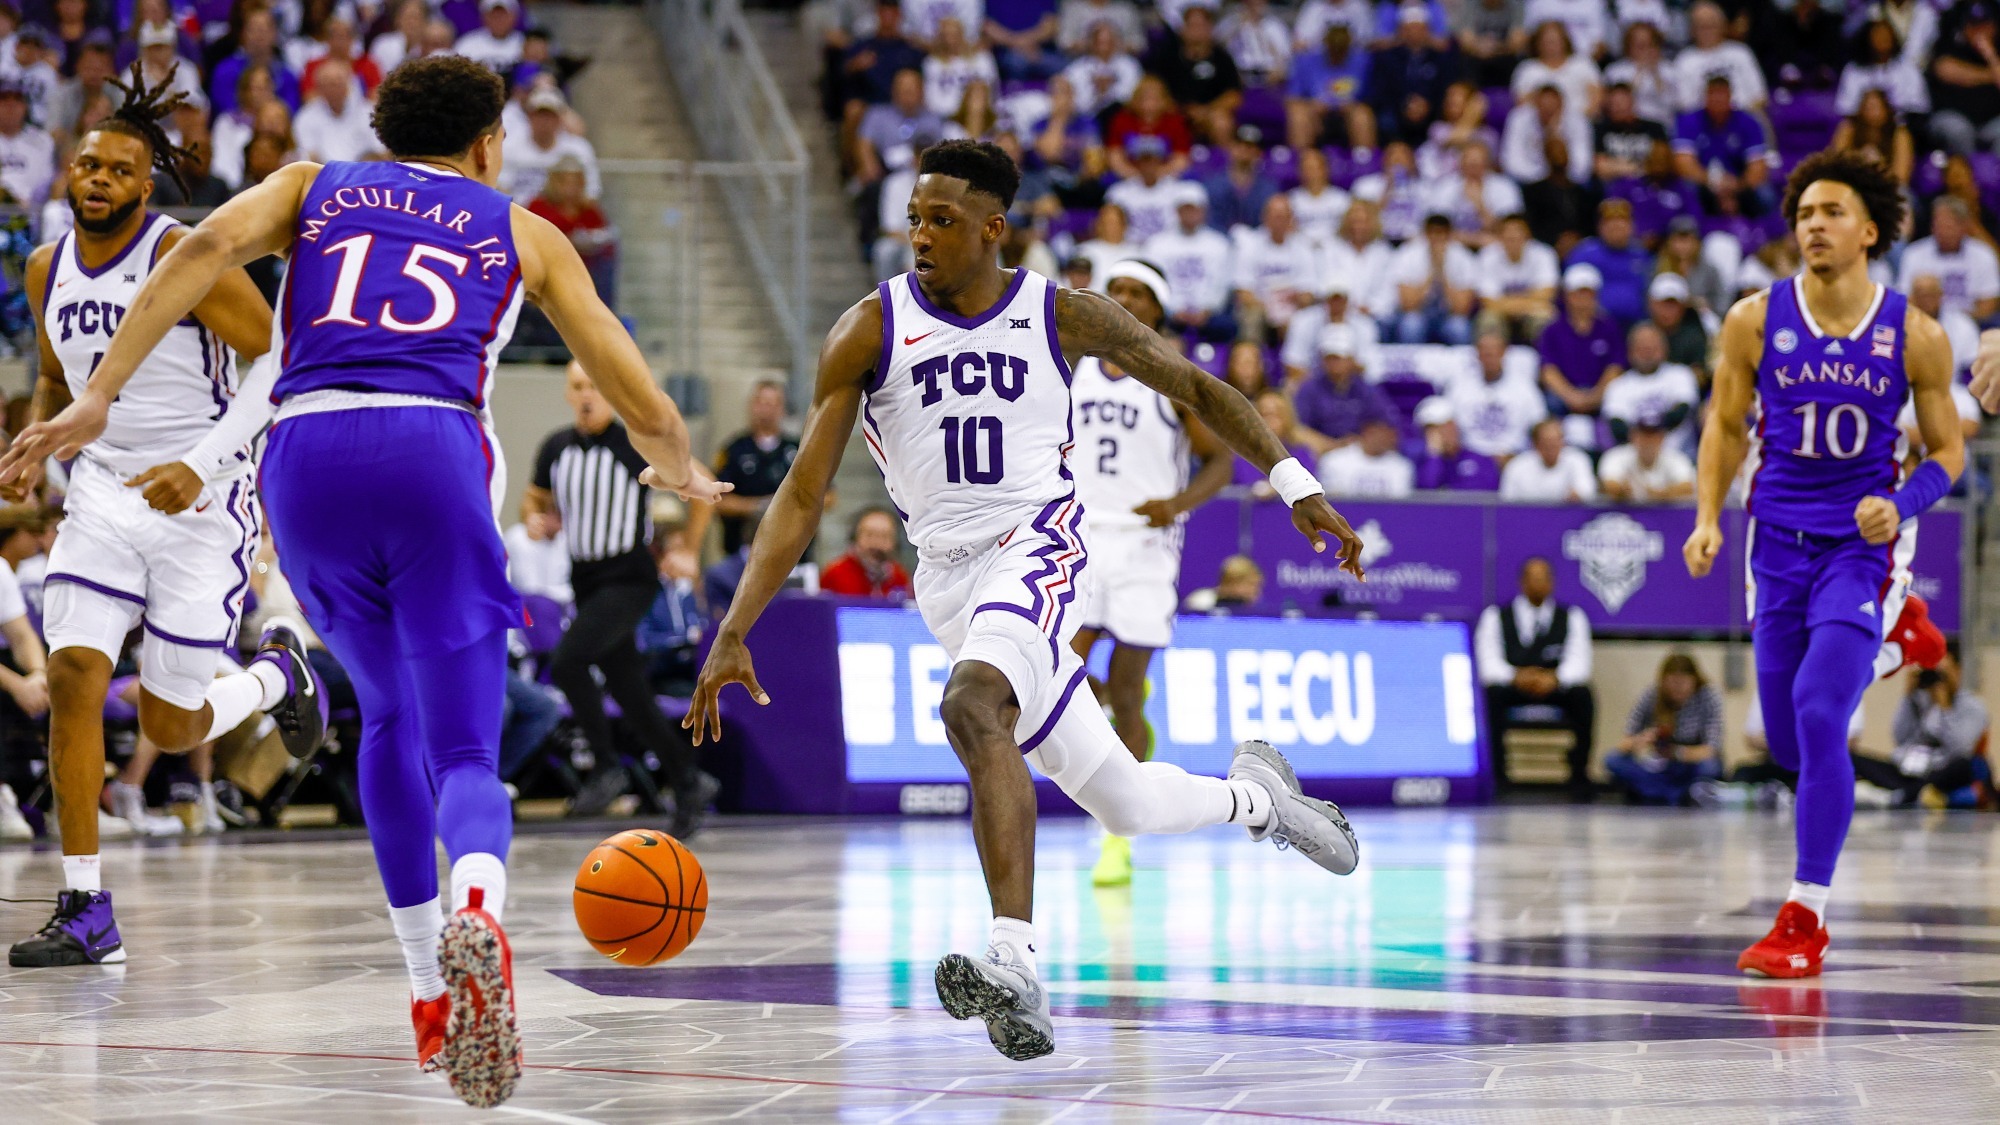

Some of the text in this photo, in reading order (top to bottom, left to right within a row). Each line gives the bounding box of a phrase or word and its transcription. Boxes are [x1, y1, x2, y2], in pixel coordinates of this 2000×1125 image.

[464, 236, 508, 280] JR.
[311, 232, 470, 334] 15
[57, 300, 126, 344] TCU
[1009, 318, 1031, 329] XII
[911, 352, 1029, 408] TCU
[1774, 361, 1891, 397] KANSAS
[1080, 400, 1140, 430] TCU
[1792, 401, 1869, 460] 10
[939, 416, 1004, 484] 10
[1097, 437, 1118, 476] 2
[1226, 649, 1376, 746] EECU
